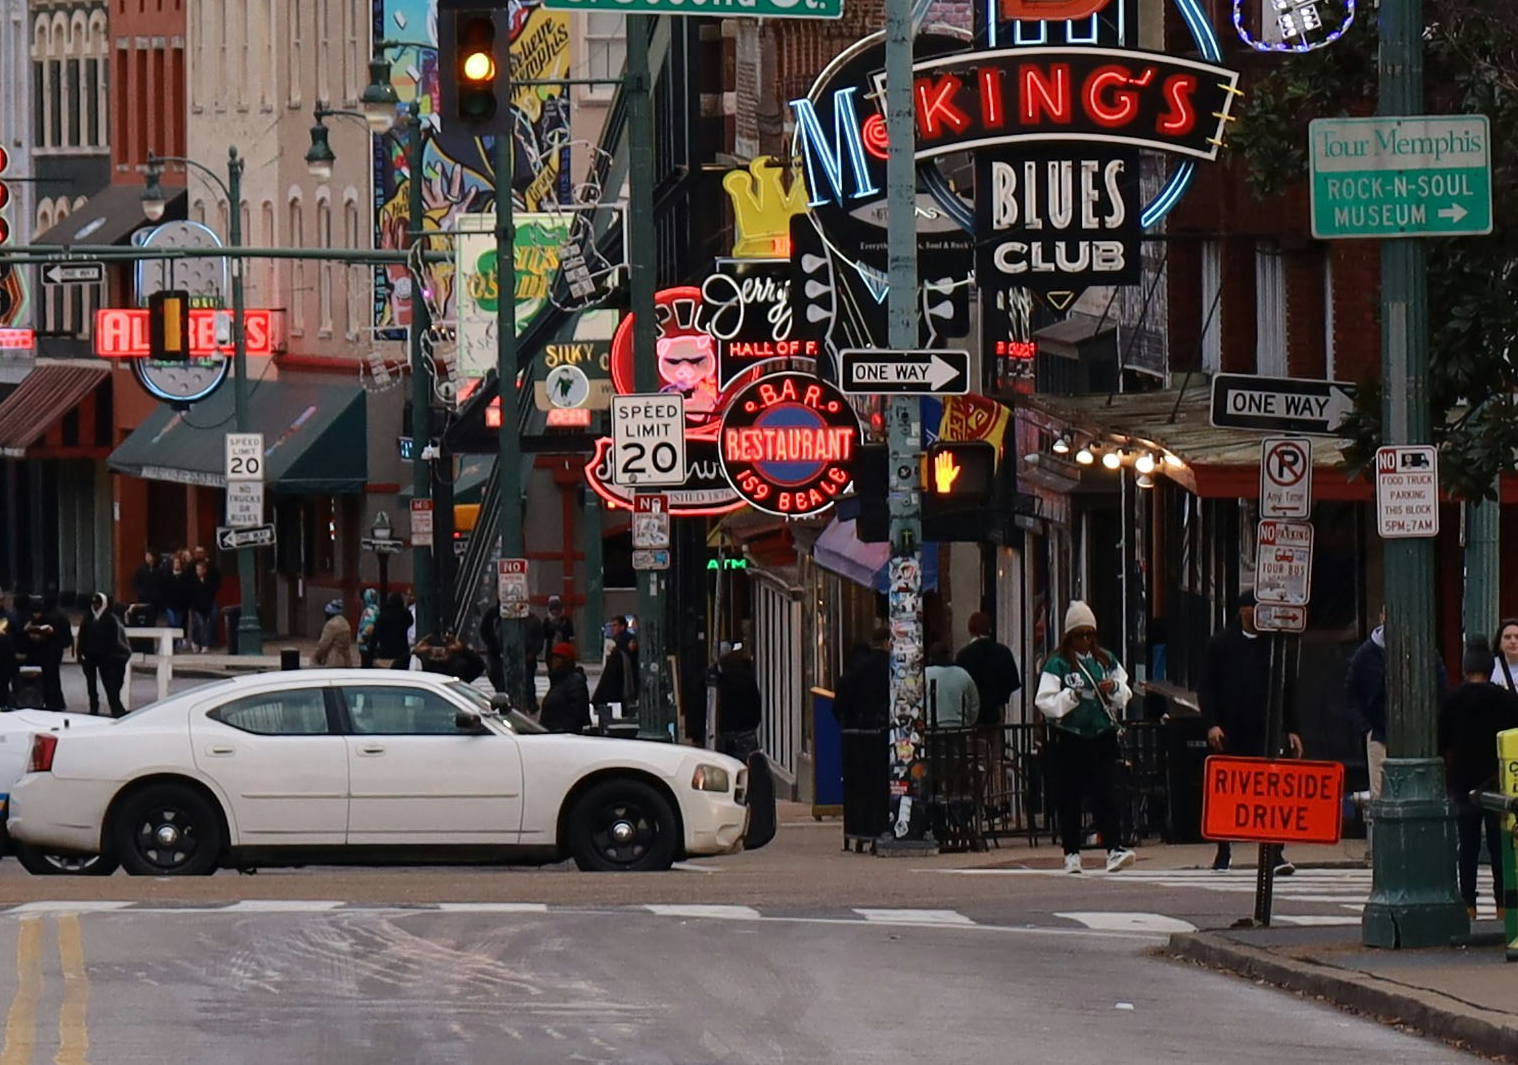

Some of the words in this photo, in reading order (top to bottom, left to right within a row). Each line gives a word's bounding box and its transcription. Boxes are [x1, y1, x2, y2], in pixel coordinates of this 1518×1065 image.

[914, 60, 1198, 140] KING'S
[1324, 131, 1369, 158] Tour
[1373, 128, 1482, 161] Memphis
[991, 159, 1126, 231] BLUES
[1327, 173, 1475, 200] ROCK-N-SOUL
[1334, 203, 1427, 228] MUSEUM
[993, 240, 1126, 274] CLUB
[701, 273, 793, 342] Jerry
[545, 343, 595, 368] SILKY
[729, 342, 773, 357] HALL
[775, 341, 799, 356] OF
[855, 364, 889, 380] ONE
[895, 364, 931, 381] WAY
[759, 379, 823, 409] BAR
[618, 405, 678, 420] SPEED
[1232, 392, 1276, 414] ONE
[1284, 395, 1331, 418] WAY
[625, 424, 672, 438] LIMIT
[229, 438, 260, 447] SPEED
[725, 427, 853, 462] RESTAURANT
[230, 457, 260, 475] 20
[621, 441, 678, 474] 20
[1380, 452, 1396, 469] NO
[736, 469, 770, 500] 159
[777, 466, 850, 511] BEALE
[1382, 475, 1404, 485] FOOD
[1406, 475, 1432, 485] TRUCK
[239, 485, 251, 494] NO
[1266, 491, 1282, 504] Any
[1285, 491, 1304, 503] Time
[1389, 490, 1426, 501] PARKING
[229, 495, 261, 503] TRUCKS
[1385, 506, 1404, 515] THIS
[1405, 505, 1432, 515] BLOCK
[1260, 525, 1276, 542] NO
[1275, 528, 1309, 542] PARKING
[504, 562, 521, 573] NO
[706, 557, 747, 569] ATM
[1262, 561, 1284, 574] TOUR
[1288, 565, 1305, 576] BUS
[1214, 768, 1333, 800] RIVERSIDE
[1234, 803, 1309, 831] DRIVE
